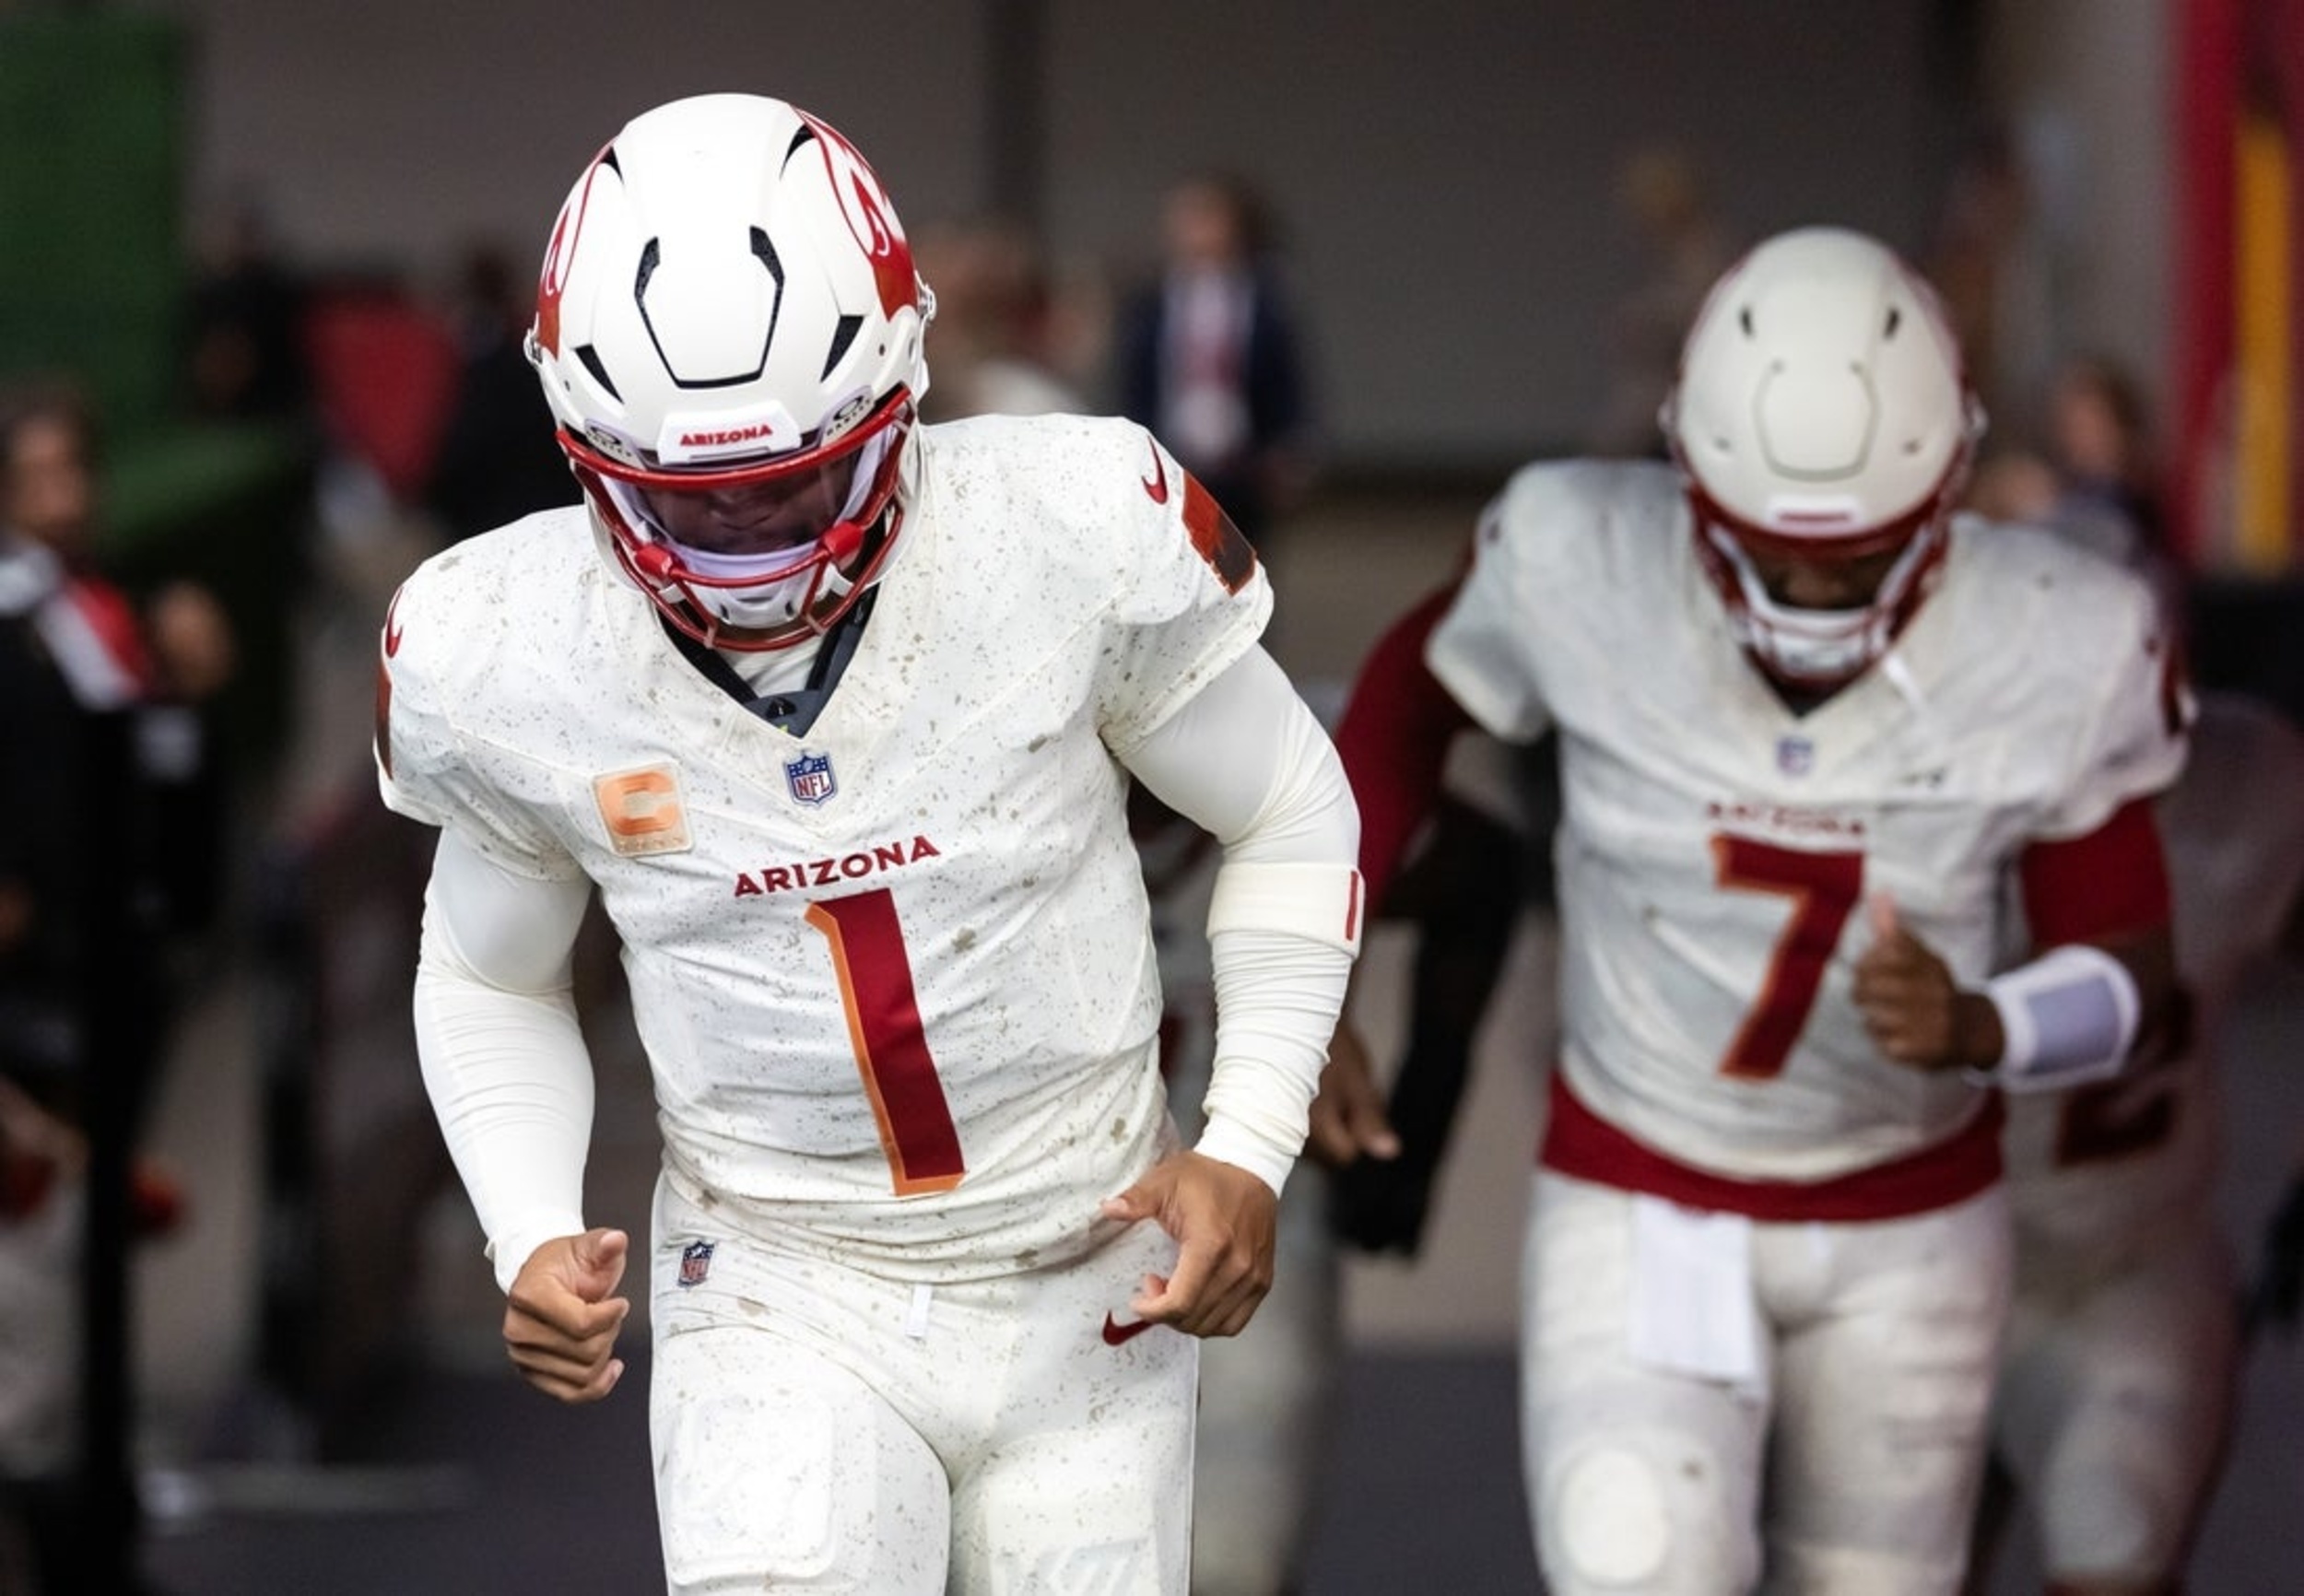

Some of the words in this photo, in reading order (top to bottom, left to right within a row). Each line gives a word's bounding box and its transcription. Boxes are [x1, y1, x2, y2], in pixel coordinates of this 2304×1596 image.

[679, 424, 773, 446] ARIZONA
[600, 770, 677, 837] C
[794, 773, 830, 797] NFL
[735, 834, 941, 898] ARIZONA
[1709, 830, 1867, 1083] 7
[804, 886, 966, 1197] 1
